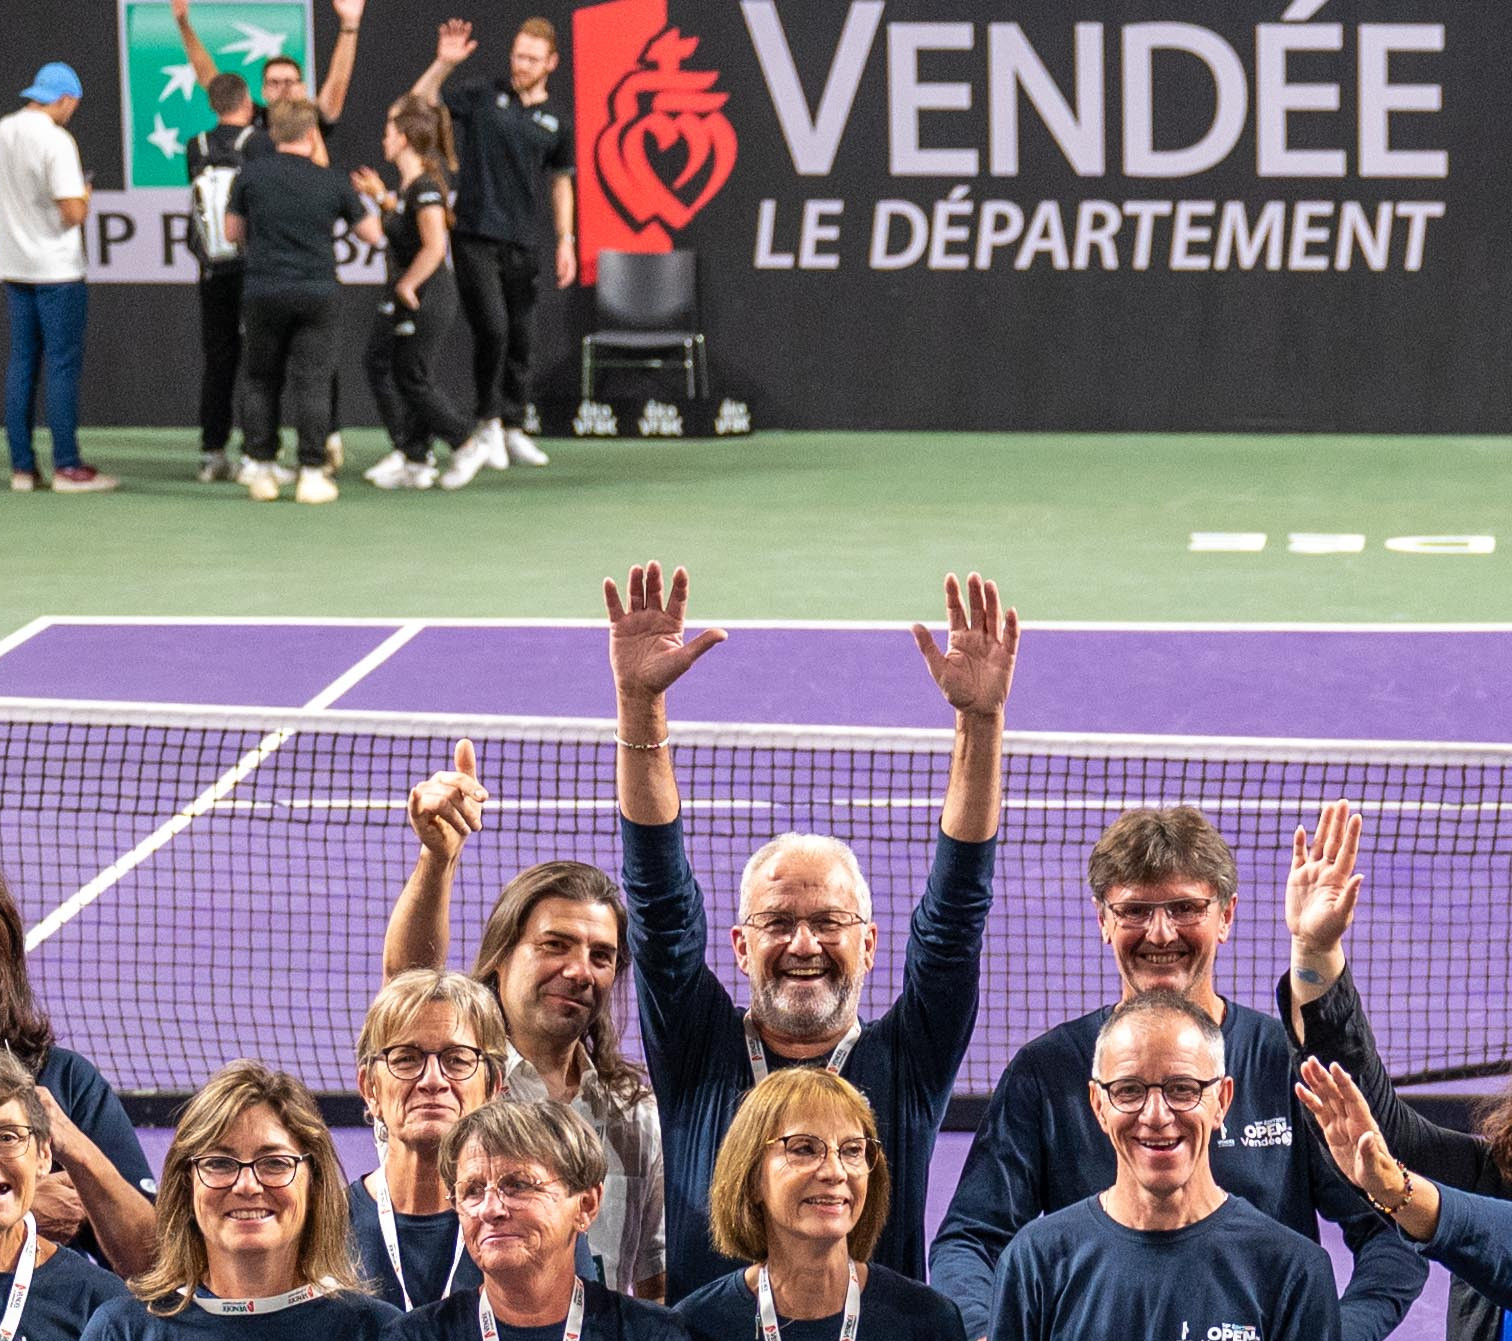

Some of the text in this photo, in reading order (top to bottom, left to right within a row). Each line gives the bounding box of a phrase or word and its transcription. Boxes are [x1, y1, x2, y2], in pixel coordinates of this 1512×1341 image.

[740, 0, 1449, 179] VENDÉE
[753, 187, 1447, 272] LE DÉPARTEMENT
[1244, 1122, 1287, 1138] OPEN
